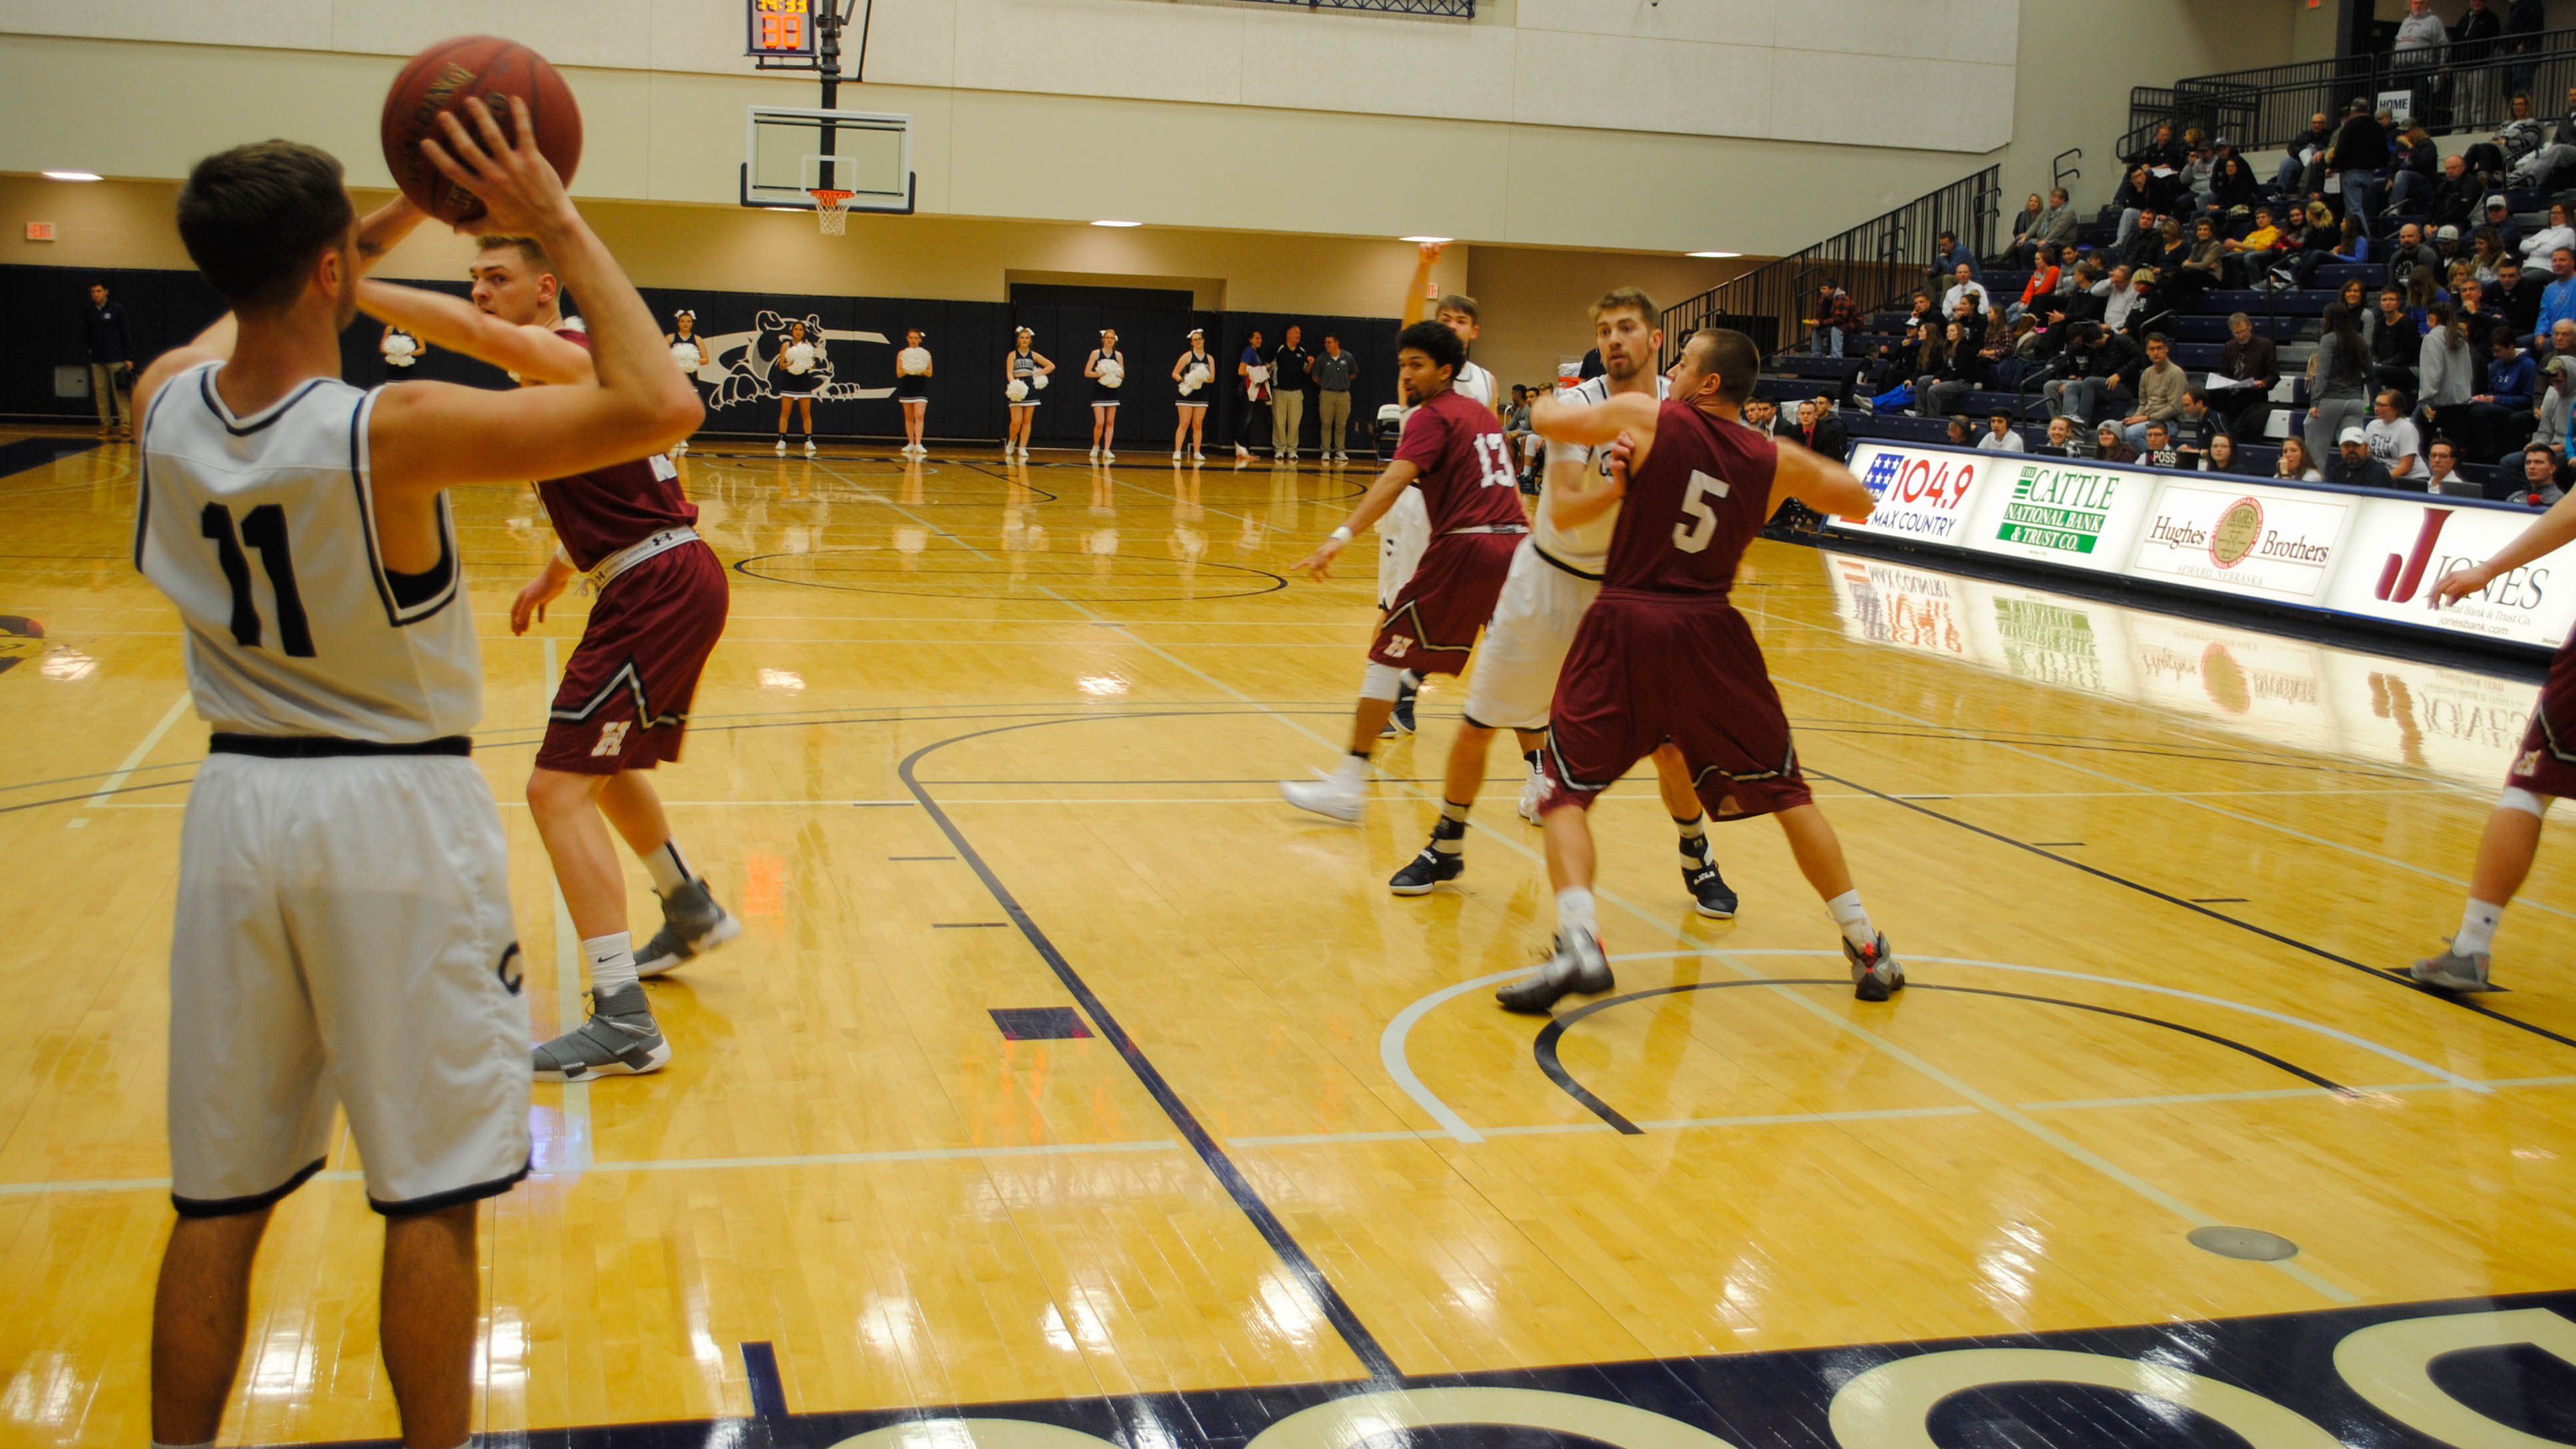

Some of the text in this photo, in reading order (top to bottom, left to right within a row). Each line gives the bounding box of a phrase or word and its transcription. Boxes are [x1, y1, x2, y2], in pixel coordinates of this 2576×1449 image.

[762, 15, 801, 47] 30
[2380, 98, 2408, 110] HOME
[1473, 433, 1515, 488] 13
[2153, 450, 2176, 464] POSS
[1891, 458, 1974, 510] 104.9
[2021, 468, 2036, 477] THE
[2029, 469, 2120, 510] CATTLE
[1671, 469, 1730, 554] 5
[1871, 510, 1957, 538] MAX COUNTRY
[2005, 504, 2104, 532] NATIONAL BANK
[2011, 526, 2078, 551] & TRUST CO.
[2150, 516, 2207, 550] Hughes
[2261, 530, 2330, 563] Brothers
[200, 500, 317, 657] 11
[2176, 564, 2263, 586] SEWARD, NEBRASKA
[2437, 615, 2509, 636] jonesbank.com
[2464, 606, 2487, 619] Bank
[2487, 610, 2495, 620] &
[2495, 610, 2517, 624] Trust
